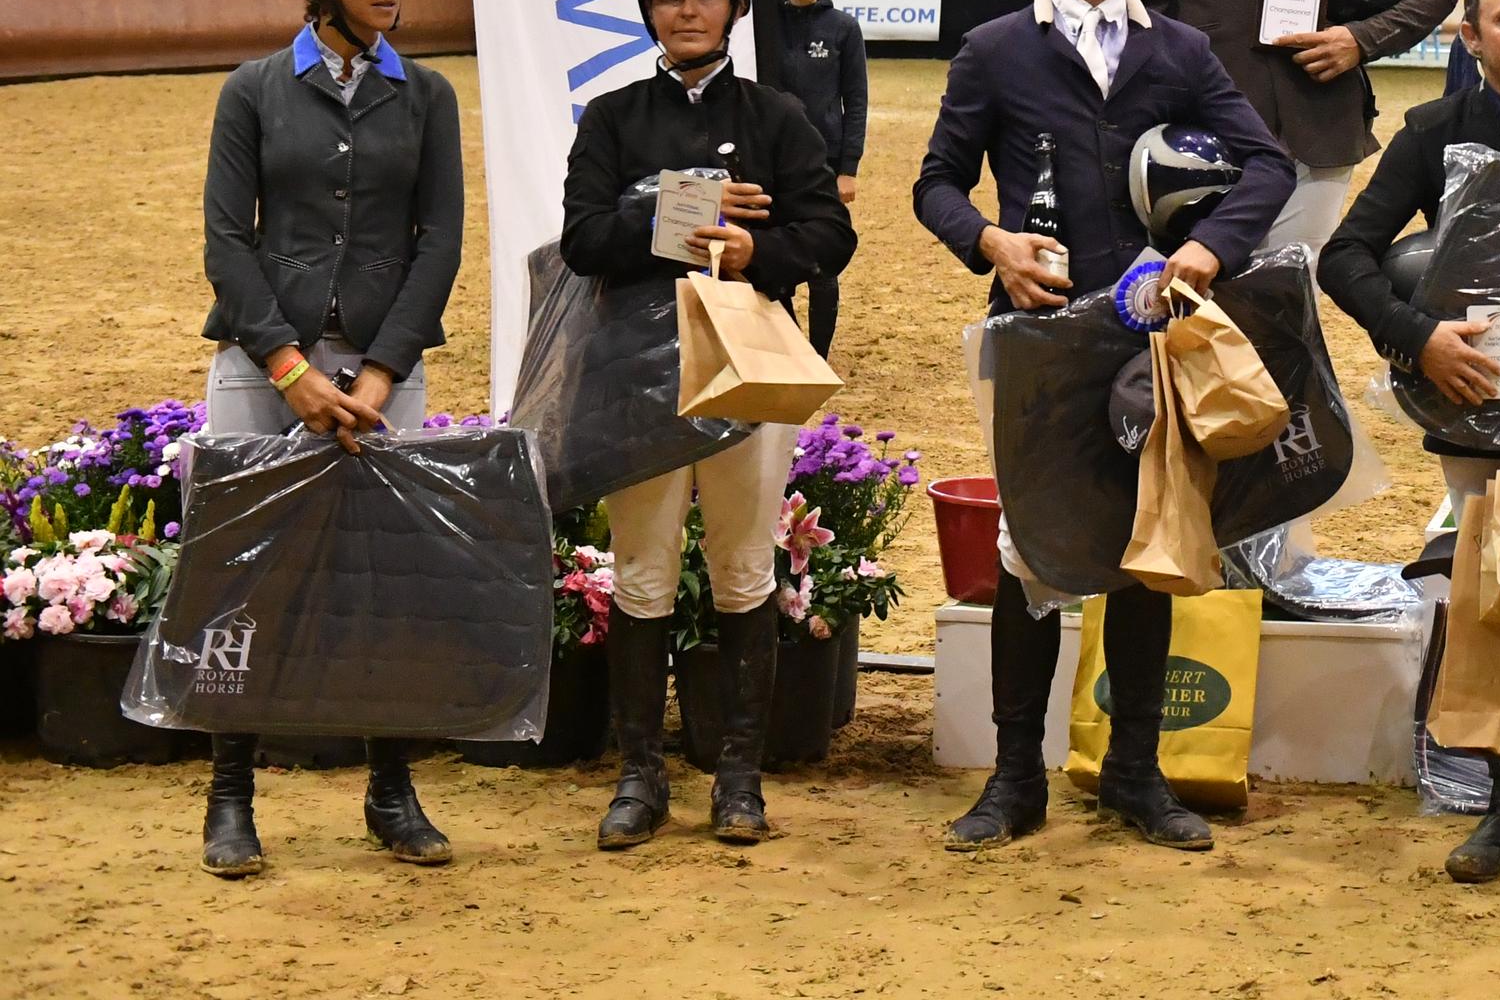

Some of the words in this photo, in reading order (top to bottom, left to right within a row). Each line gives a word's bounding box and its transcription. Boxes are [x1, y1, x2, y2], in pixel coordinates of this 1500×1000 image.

[1281, 451, 1321, 473] ROYAL
[1284, 459, 1327, 483] HORSE
[197, 671, 245, 682] ROYAL
[195, 683, 244, 694] HORSE
